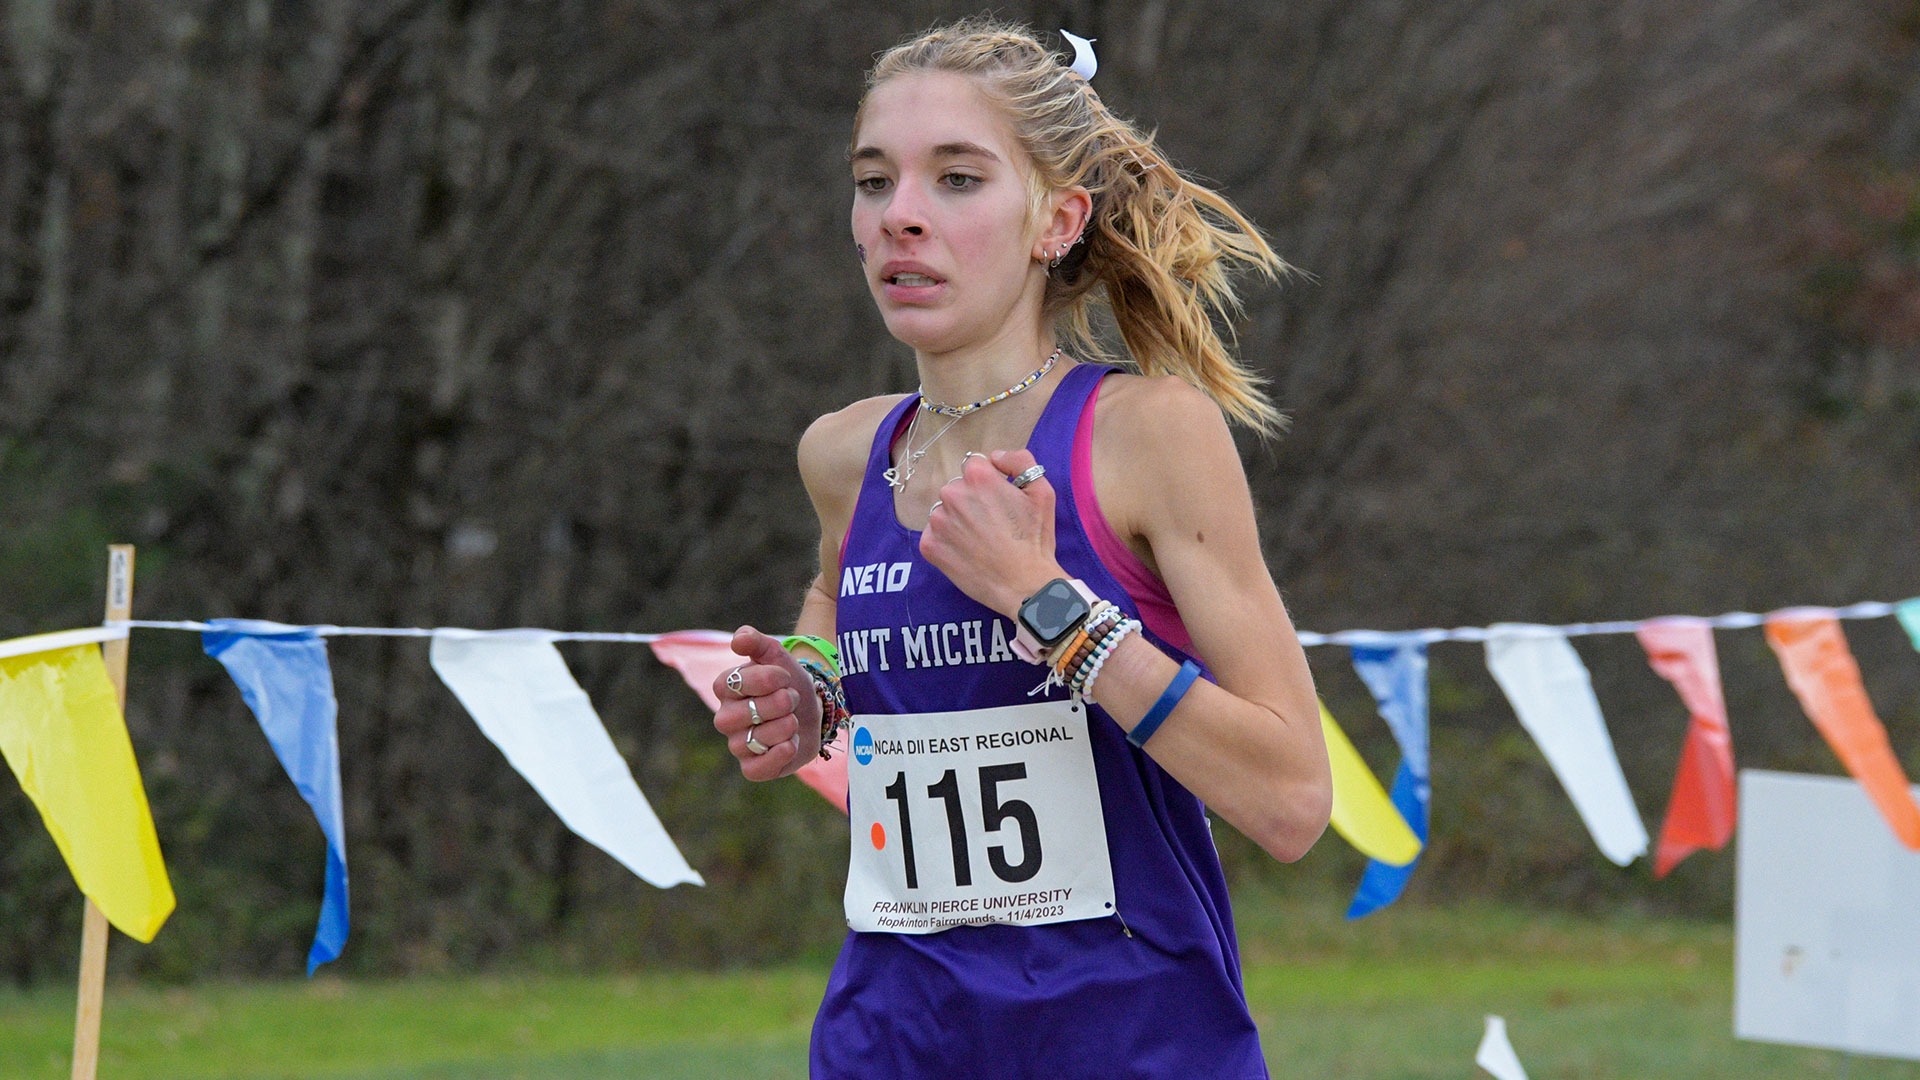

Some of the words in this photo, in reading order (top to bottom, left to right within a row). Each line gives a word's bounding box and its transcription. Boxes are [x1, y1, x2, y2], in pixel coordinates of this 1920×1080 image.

[841, 562, 912, 597] NE10
[902, 618, 1021, 669] MICHA
[855, 744, 873, 756] NCAA
[874, 740, 904, 755] NCAA
[908, 739, 925, 754] DII
[930, 736, 970, 753] EAST
[976, 726, 1073, 750] REGIONAL
[885, 762, 1043, 889] 115
[872, 902, 927, 914] FRANKLIN
[931, 898, 978, 914] PIERCE
[983, 888, 1072, 910] UNIVERSITY
[877, 916, 928, 929] Hopkinton
[930, 915, 996, 928] Fairgrounds
[1007, 905, 1064, 923] 11/4/2023
